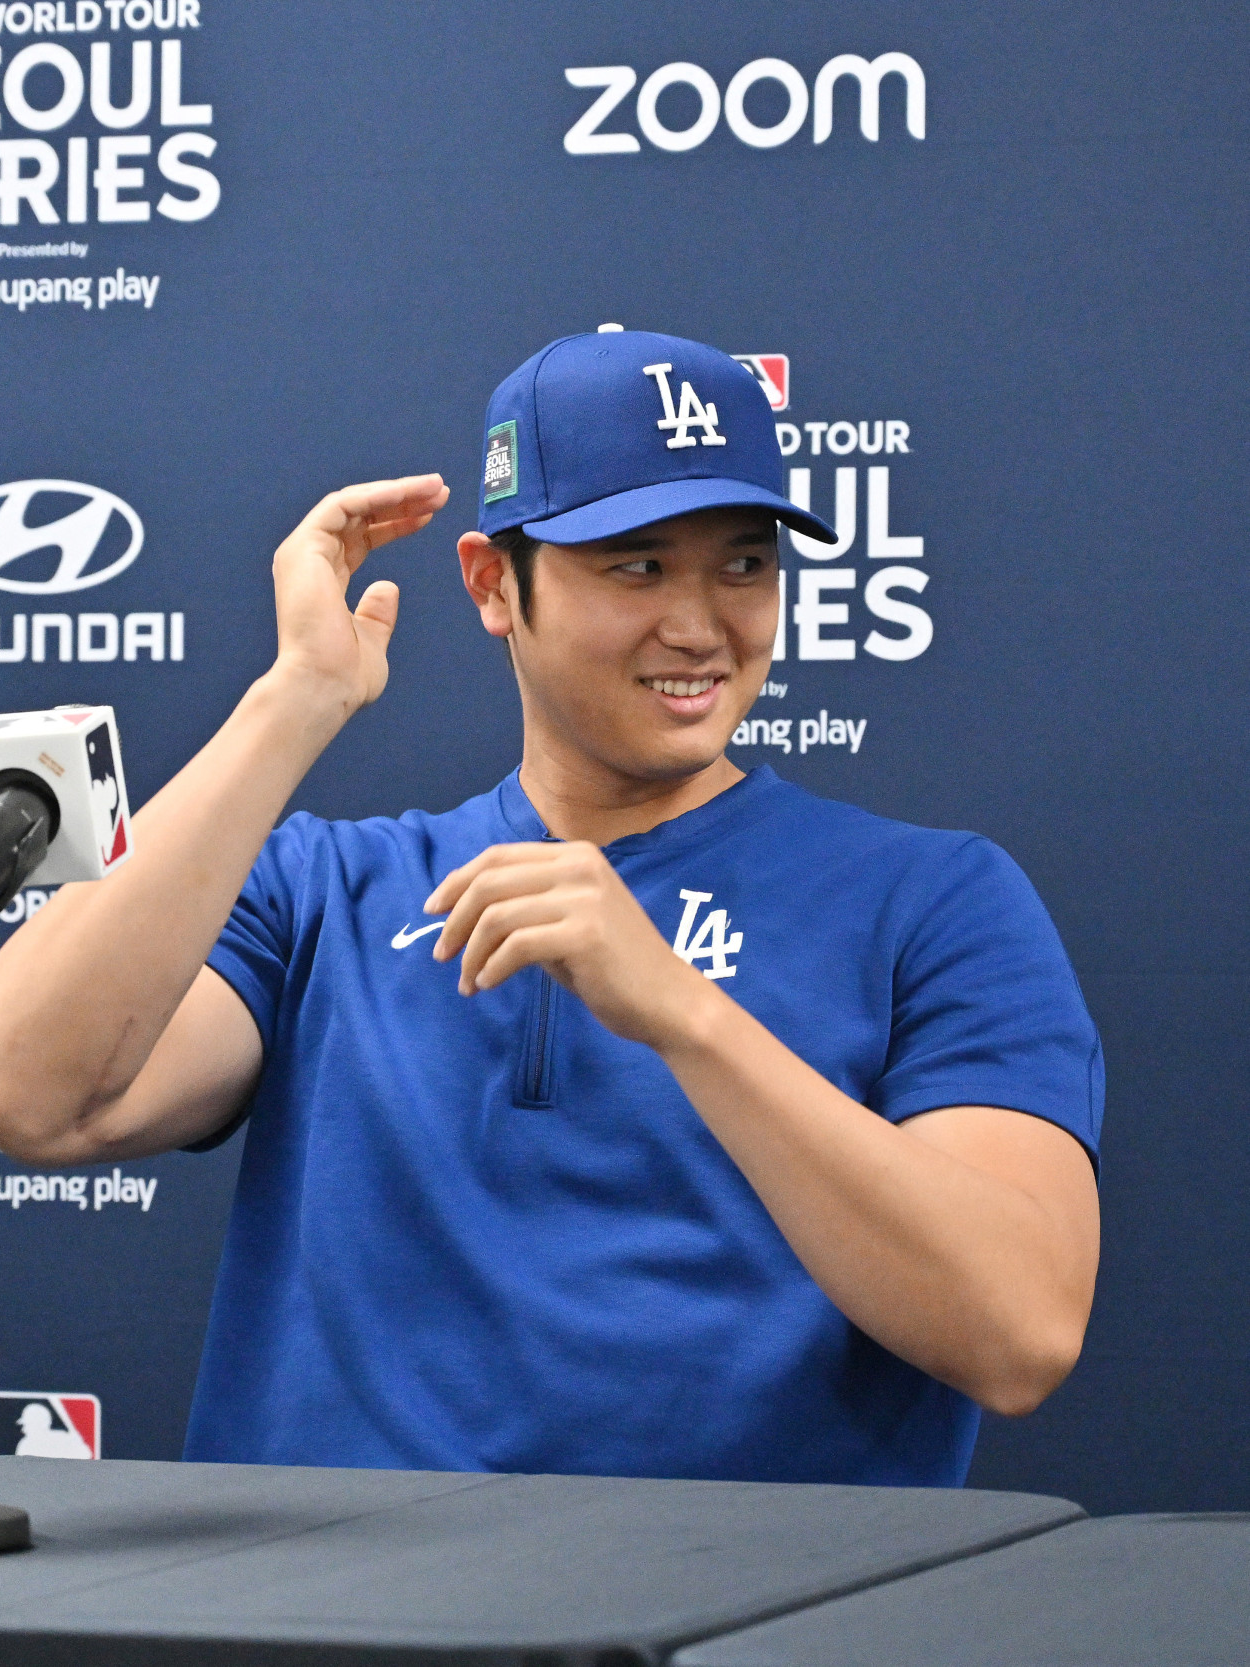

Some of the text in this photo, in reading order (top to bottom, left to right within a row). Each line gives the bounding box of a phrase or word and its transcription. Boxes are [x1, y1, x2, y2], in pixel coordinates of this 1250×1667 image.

[105, 0, 200, 31] TOUR
[563, 51, 926, 155] zoom
[70, 240, 89, 259] by
[97, 267, 161, 310] play
[642, 362, 727, 450] LA
[804, 420, 911, 455] TOUR
[768, 680, 789, 699] by
[800, 709, 867, 754] play
[673, 888, 743, 980] LA
[94, 1167, 157, 1212] play
